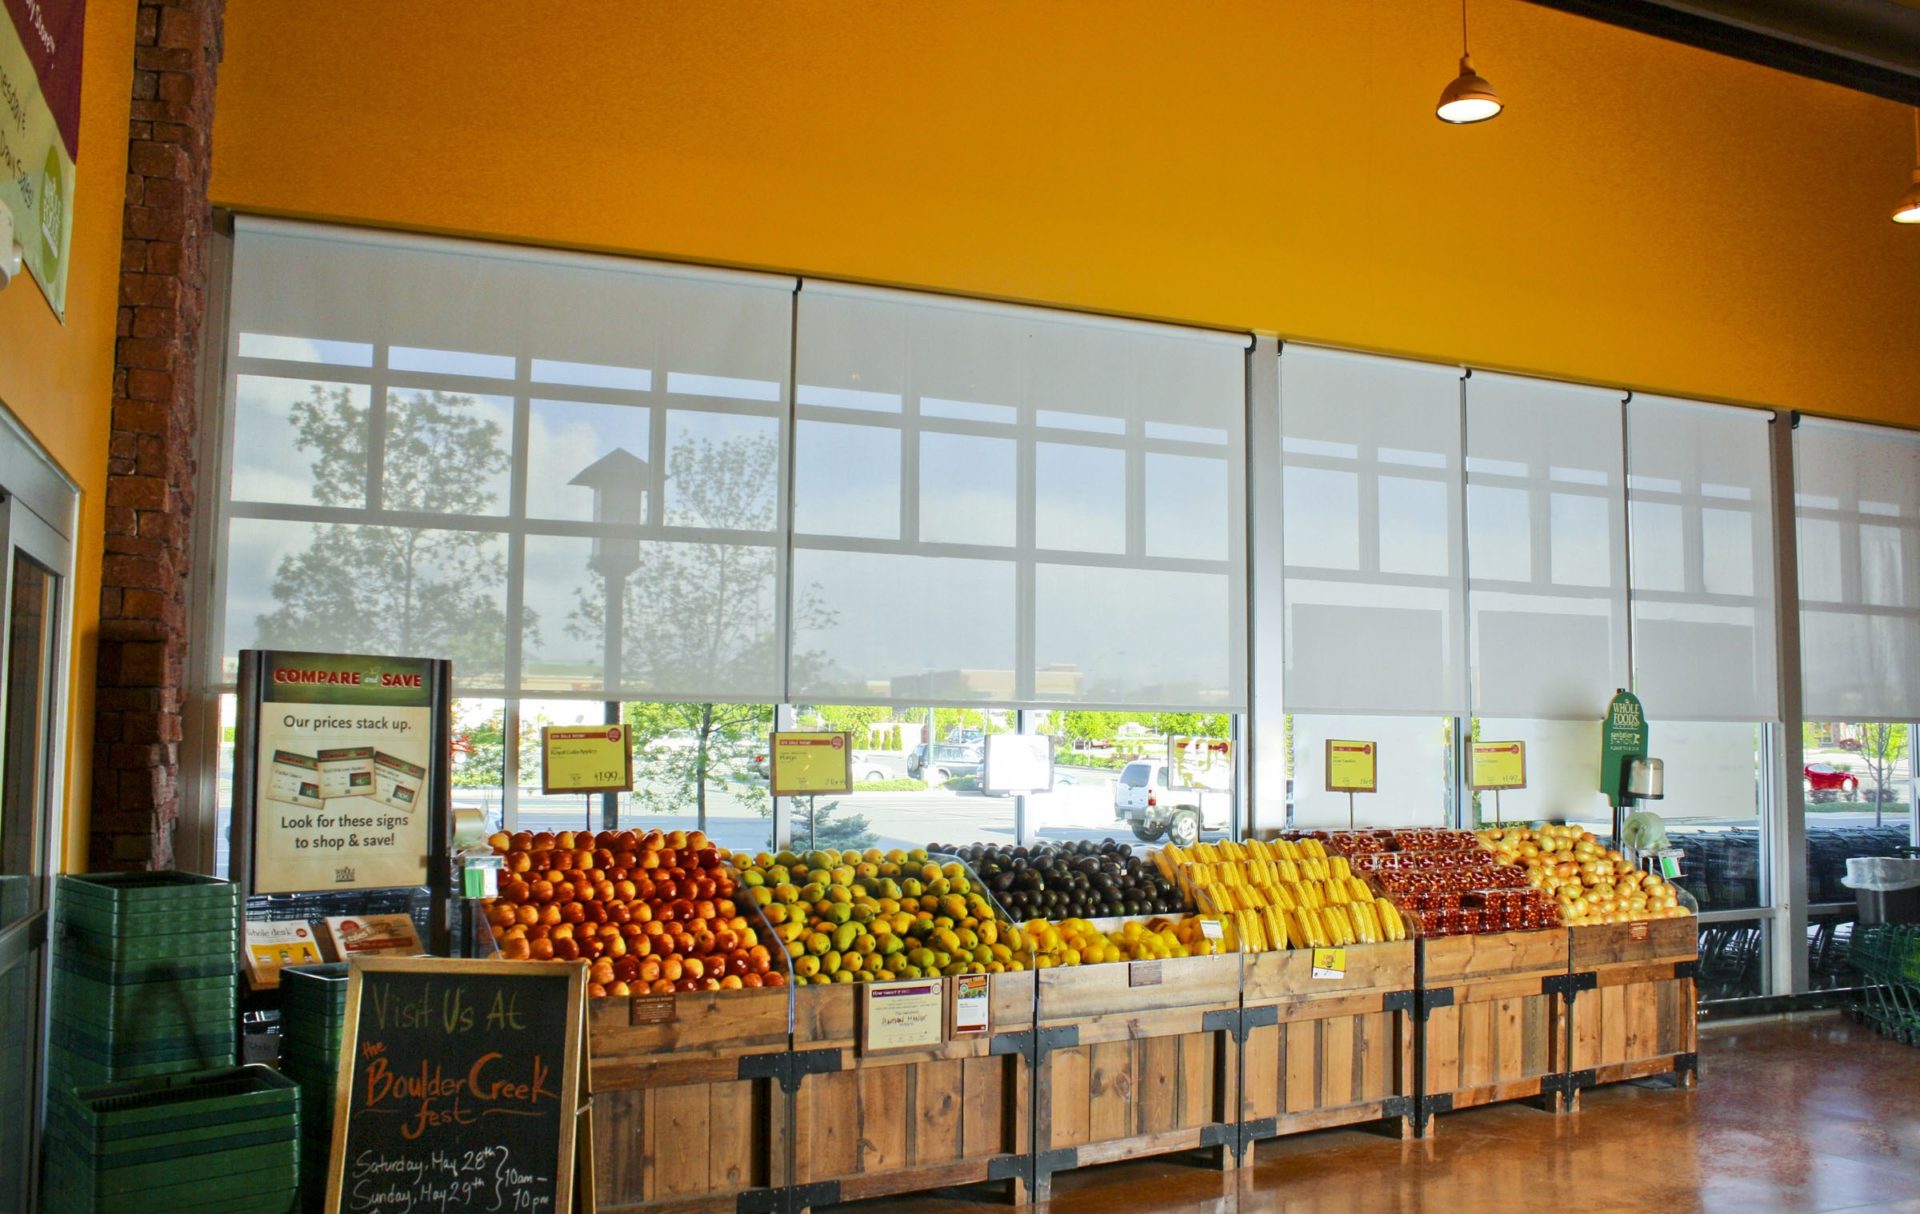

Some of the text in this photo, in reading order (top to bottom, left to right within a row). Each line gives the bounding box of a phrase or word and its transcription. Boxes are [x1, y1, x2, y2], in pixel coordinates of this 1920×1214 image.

[274, 667, 422, 689] COMPARE and SAVE
[1613, 702, 1640, 713] WHOLE
[283, 714, 412, 733] Our prices stack up.
[1613, 714, 1640, 727] FOODS
[281, 814, 409, 830] Look for these signs
[295, 832, 395, 851] to shop & save!
[372, 982, 526, 1034] Visit Us At
[362, 1041, 386, 1060] the
[366, 1051, 558, 1107] Boulder Creek
[352, 1149, 428, 1185] Saturday,
[432, 1149, 458, 1177] May
[505, 1167, 534, 1188] 10am
[350, 1179, 417, 1214] Sunday,
[420, 1181, 447, 1214] May
